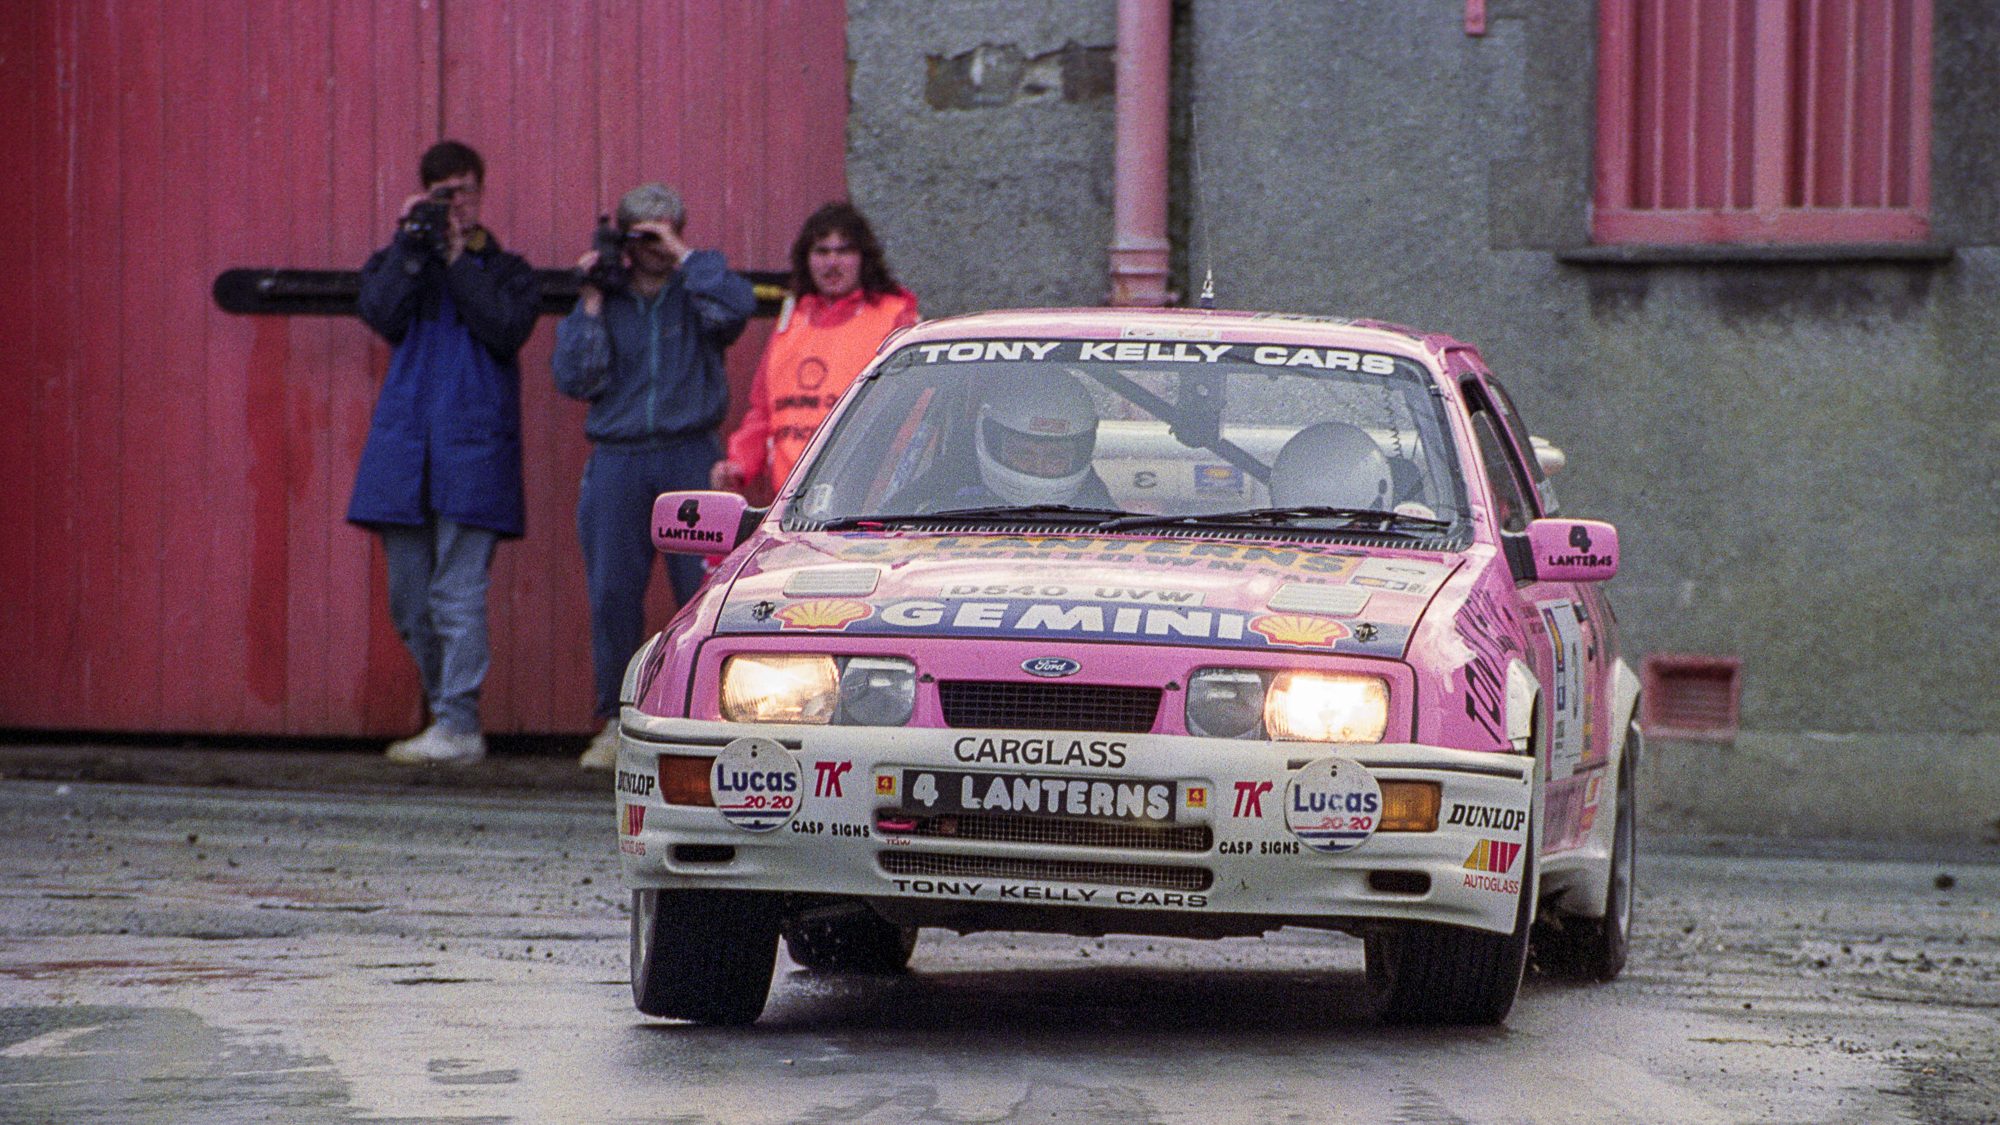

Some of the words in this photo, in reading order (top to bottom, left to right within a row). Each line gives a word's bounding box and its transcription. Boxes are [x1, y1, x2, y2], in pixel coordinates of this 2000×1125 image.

[919, 341, 1062, 363] TONY
[1079, 342, 1233, 363] KELLY
[1253, 345, 1395, 375] CARS
[677, 499, 700, 528] 4
[658, 527, 724, 543] LANTERNS
[1569, 526, 1592, 553] 4
[934, 537, 1345, 573] LANTERNS
[950, 584, 1068, 597] D540
[1094, 587, 1194, 603] UVW
[880, 600, 1244, 640] GEMINI
[1033, 656, 1068, 672] Ford
[953, 737, 1128, 768] CARGLASS
[617, 770, 655, 796] DUNLOP
[717, 763, 797, 792] Lucas
[815, 760, 852, 798] TK
[744, 795, 794, 809] 20-20
[912, 773, 939, 807] 4
[961, 775, 1170, 820] LANTERNS
[1233, 780, 1274, 818] TK
[1293, 784, 1378, 813] Lucas
[792, 820, 823, 834] CASP
[831, 823, 870, 838] SIGNS
[1321, 817, 1372, 831] 20-20
[1447, 803, 1526, 831] DUNLOP
[1219, 841, 1253, 854] CASP
[1260, 841, 1300, 855] SIGNS
[893, 878, 983, 896] TONY
[1000, 884, 1098, 902] KELLY
[1115, 890, 1208, 908] CARS
[1463, 874, 1519, 895] AUTOGLASS
